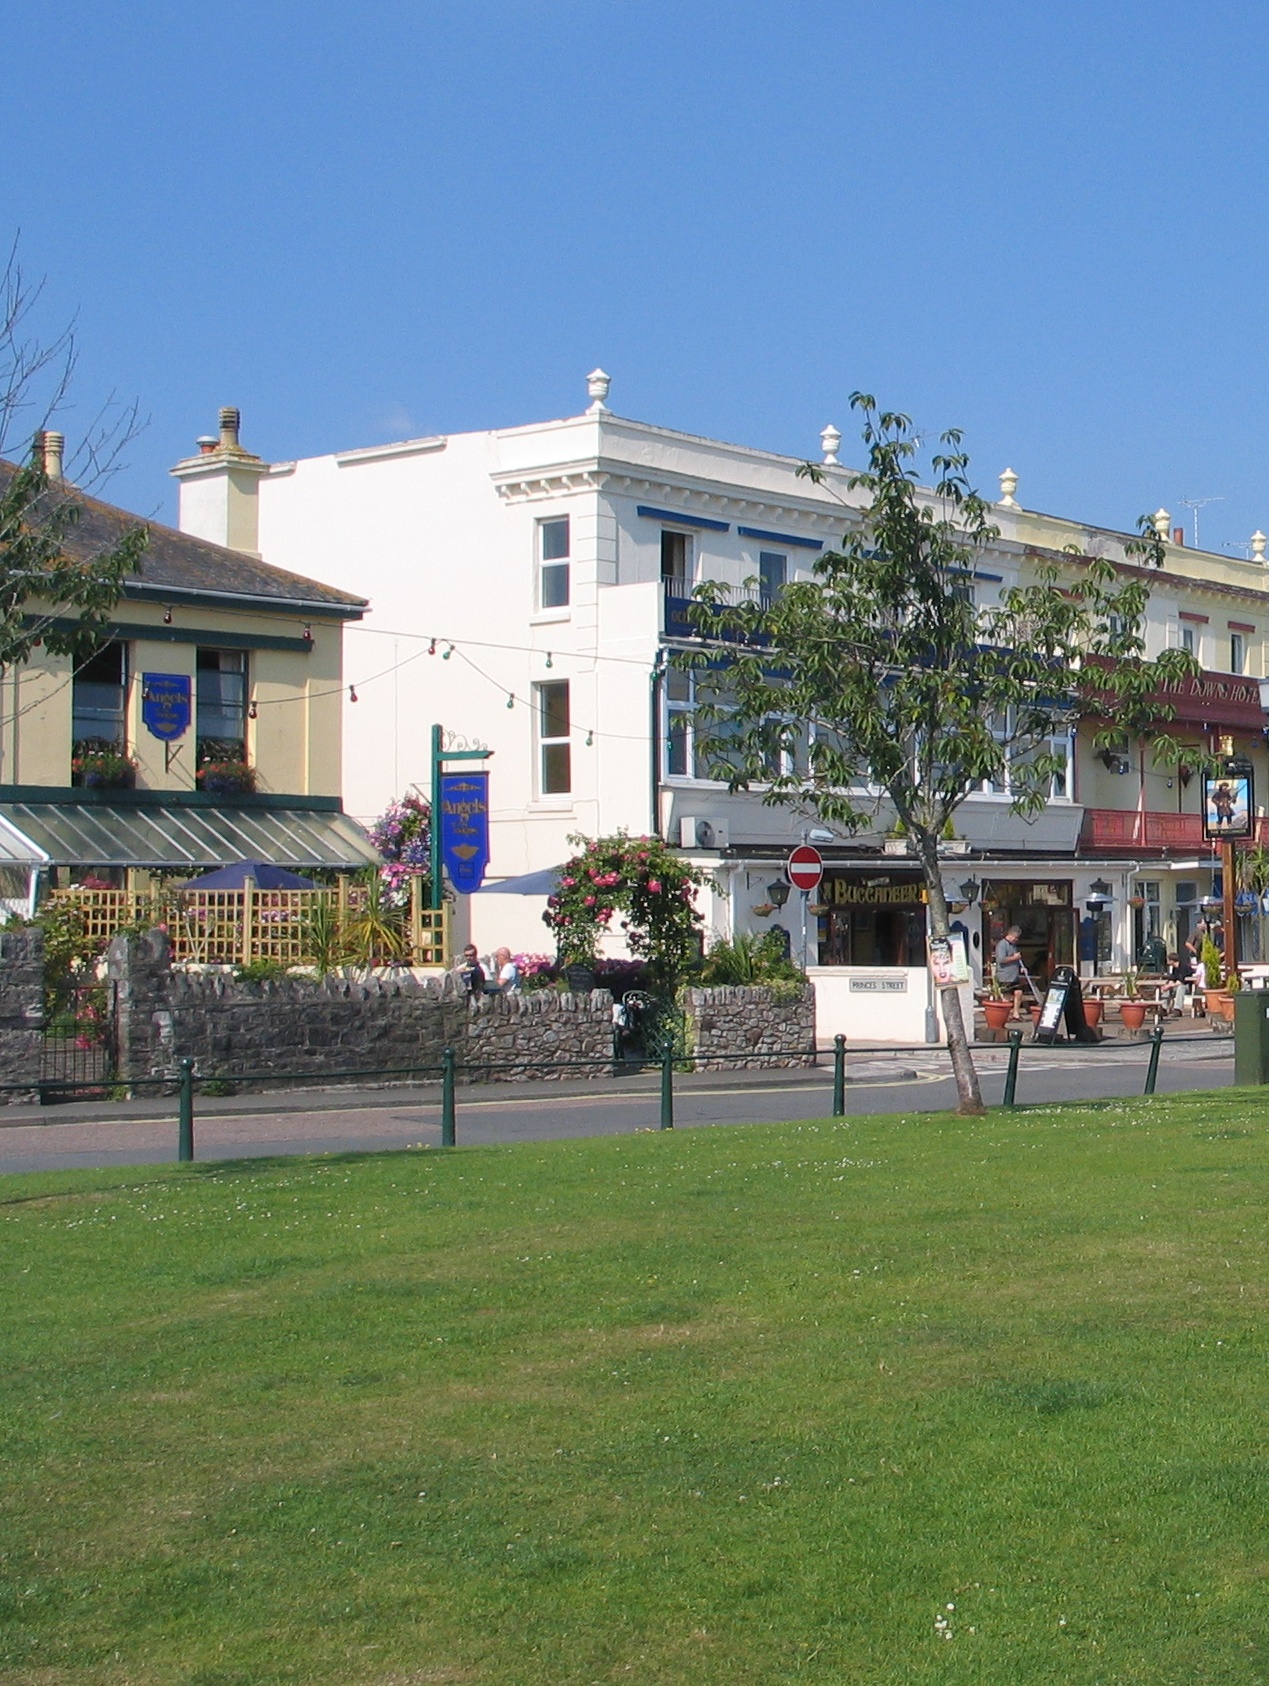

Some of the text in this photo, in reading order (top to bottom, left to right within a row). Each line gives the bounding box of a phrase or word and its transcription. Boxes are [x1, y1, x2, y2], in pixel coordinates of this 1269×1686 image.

[1190, 679, 1229, 699] DOWNS
[1230, 685, 1261, 704] HOTE
[442, 799, 487, 821] Angels
[852, 981, 904, 989] PRINCES STREET
